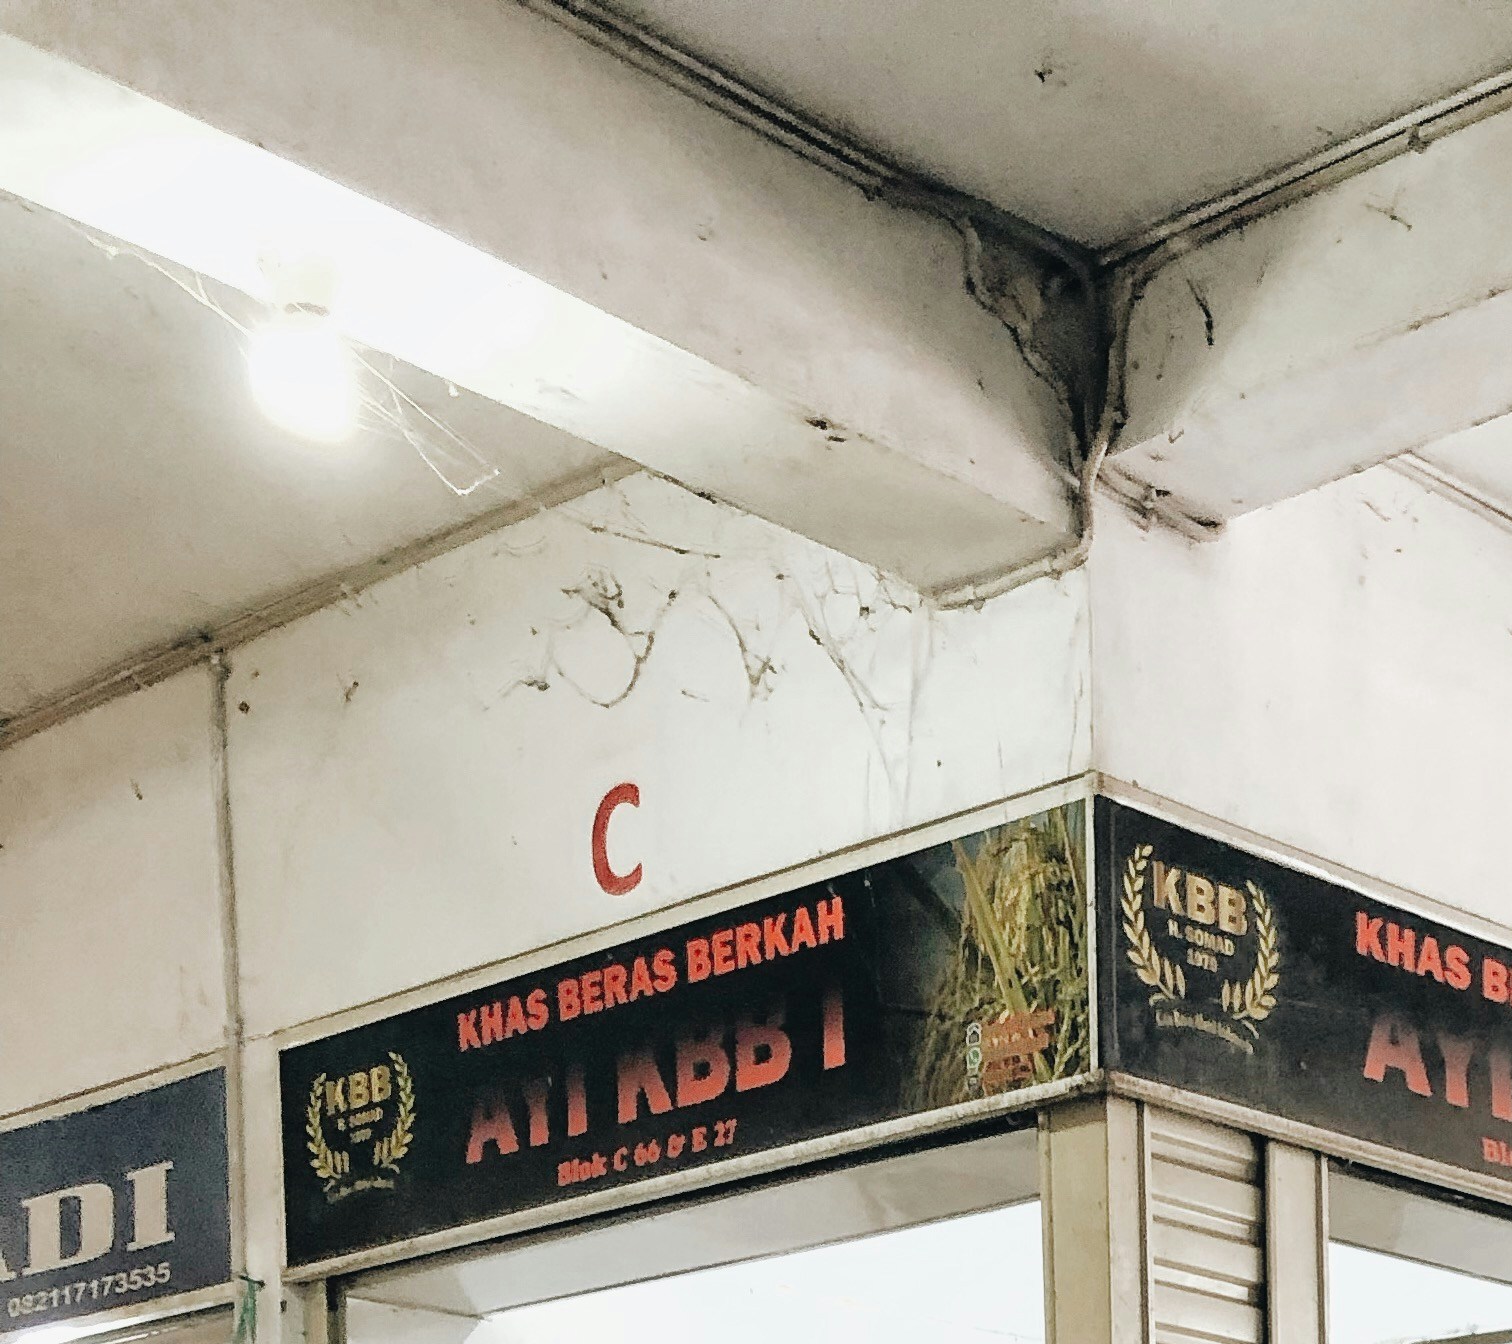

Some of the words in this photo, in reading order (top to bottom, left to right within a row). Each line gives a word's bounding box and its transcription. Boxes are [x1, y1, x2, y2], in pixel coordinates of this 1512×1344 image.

[592, 783, 643, 895] C
[1153, 860, 1248, 936] KBB
[457, 988, 550, 1052] KHAS
[557, 948, 678, 1021] BERAS
[687, 895, 845, 983] BERKAH
[1355, 910, 1472, 990] KHAS
[325, 1065, 392, 1117] KBB
[557, 1152, 607, 1187] Blok
[613, 1146, 628, 1172] C
[0, 1161, 176, 1282] DI
